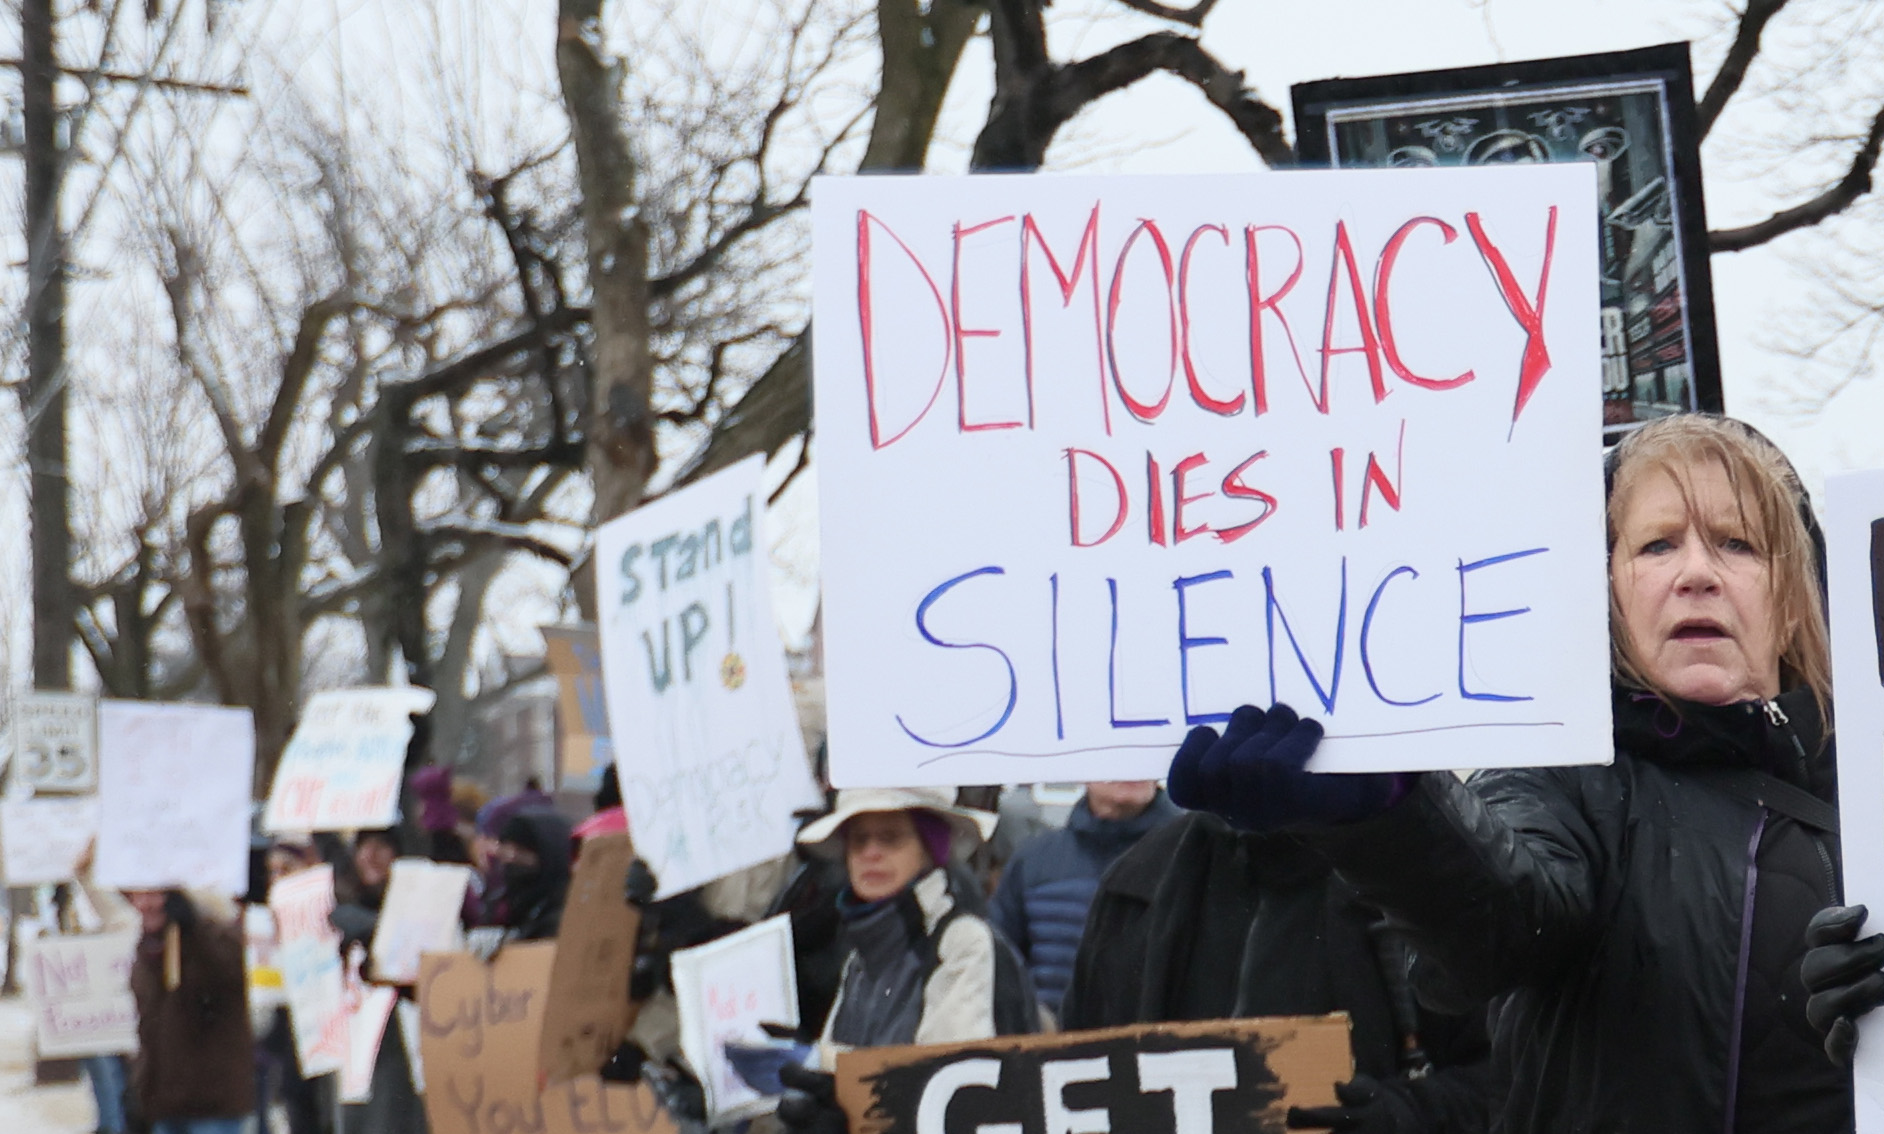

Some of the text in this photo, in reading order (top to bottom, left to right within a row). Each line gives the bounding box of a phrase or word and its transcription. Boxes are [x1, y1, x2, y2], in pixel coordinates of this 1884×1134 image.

[856, 199, 1557, 450] DEMOCRACY
[1060, 418, 1405, 548] DIES IN
[895, 547, 1549, 747] SILENCE
[25, 741, 86, 779] 35
